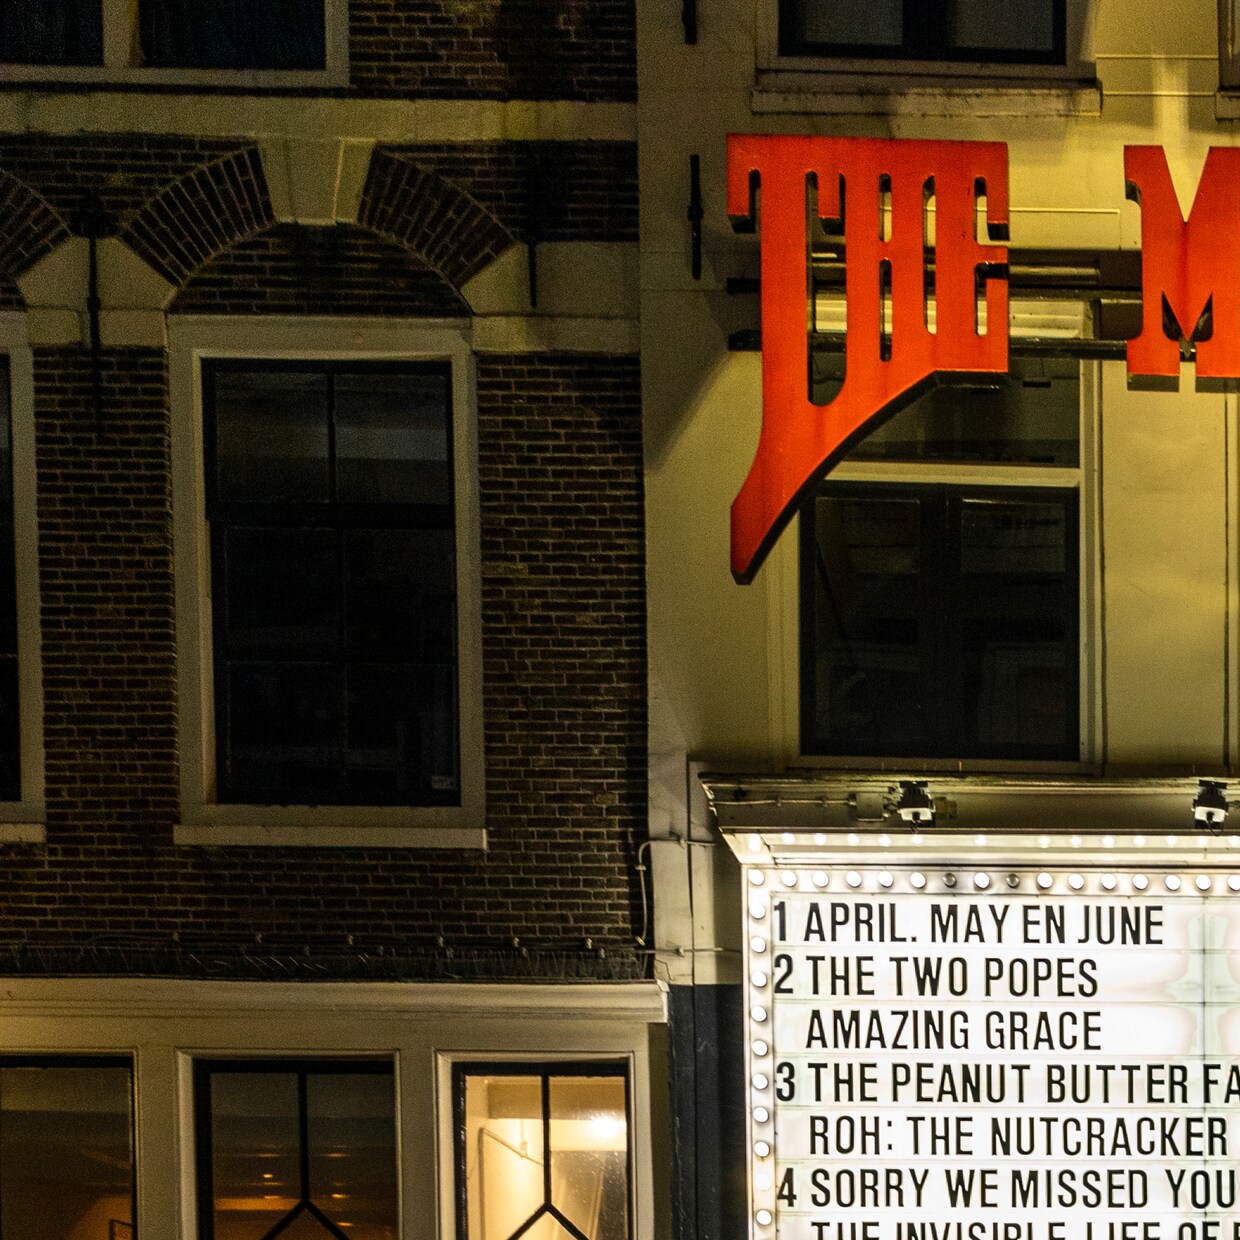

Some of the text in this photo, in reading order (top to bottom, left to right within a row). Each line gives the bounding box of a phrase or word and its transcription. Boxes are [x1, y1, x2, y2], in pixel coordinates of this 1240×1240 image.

[726, 133, 1011, 585] THE
[775, 902, 1162, 944] 1 APRIL. MAY EN JUNE
[772, 954, 1097, 997] 2 THE TWO POPES
[806, 1010, 1100, 1050] AMAZING GRACE
[774, 1062, 794, 1101] 3
[808, 1063, 877, 1101] THE
[893, 1063, 1030, 1102] PEANUT
[1048, 1065, 1187, 1103] BUTTER
[810, 1116, 1226, 1156] ROH: THE NUTCRACKER
[777, 1168, 1234, 1208] 4 SORRY WE MISSED YOU
